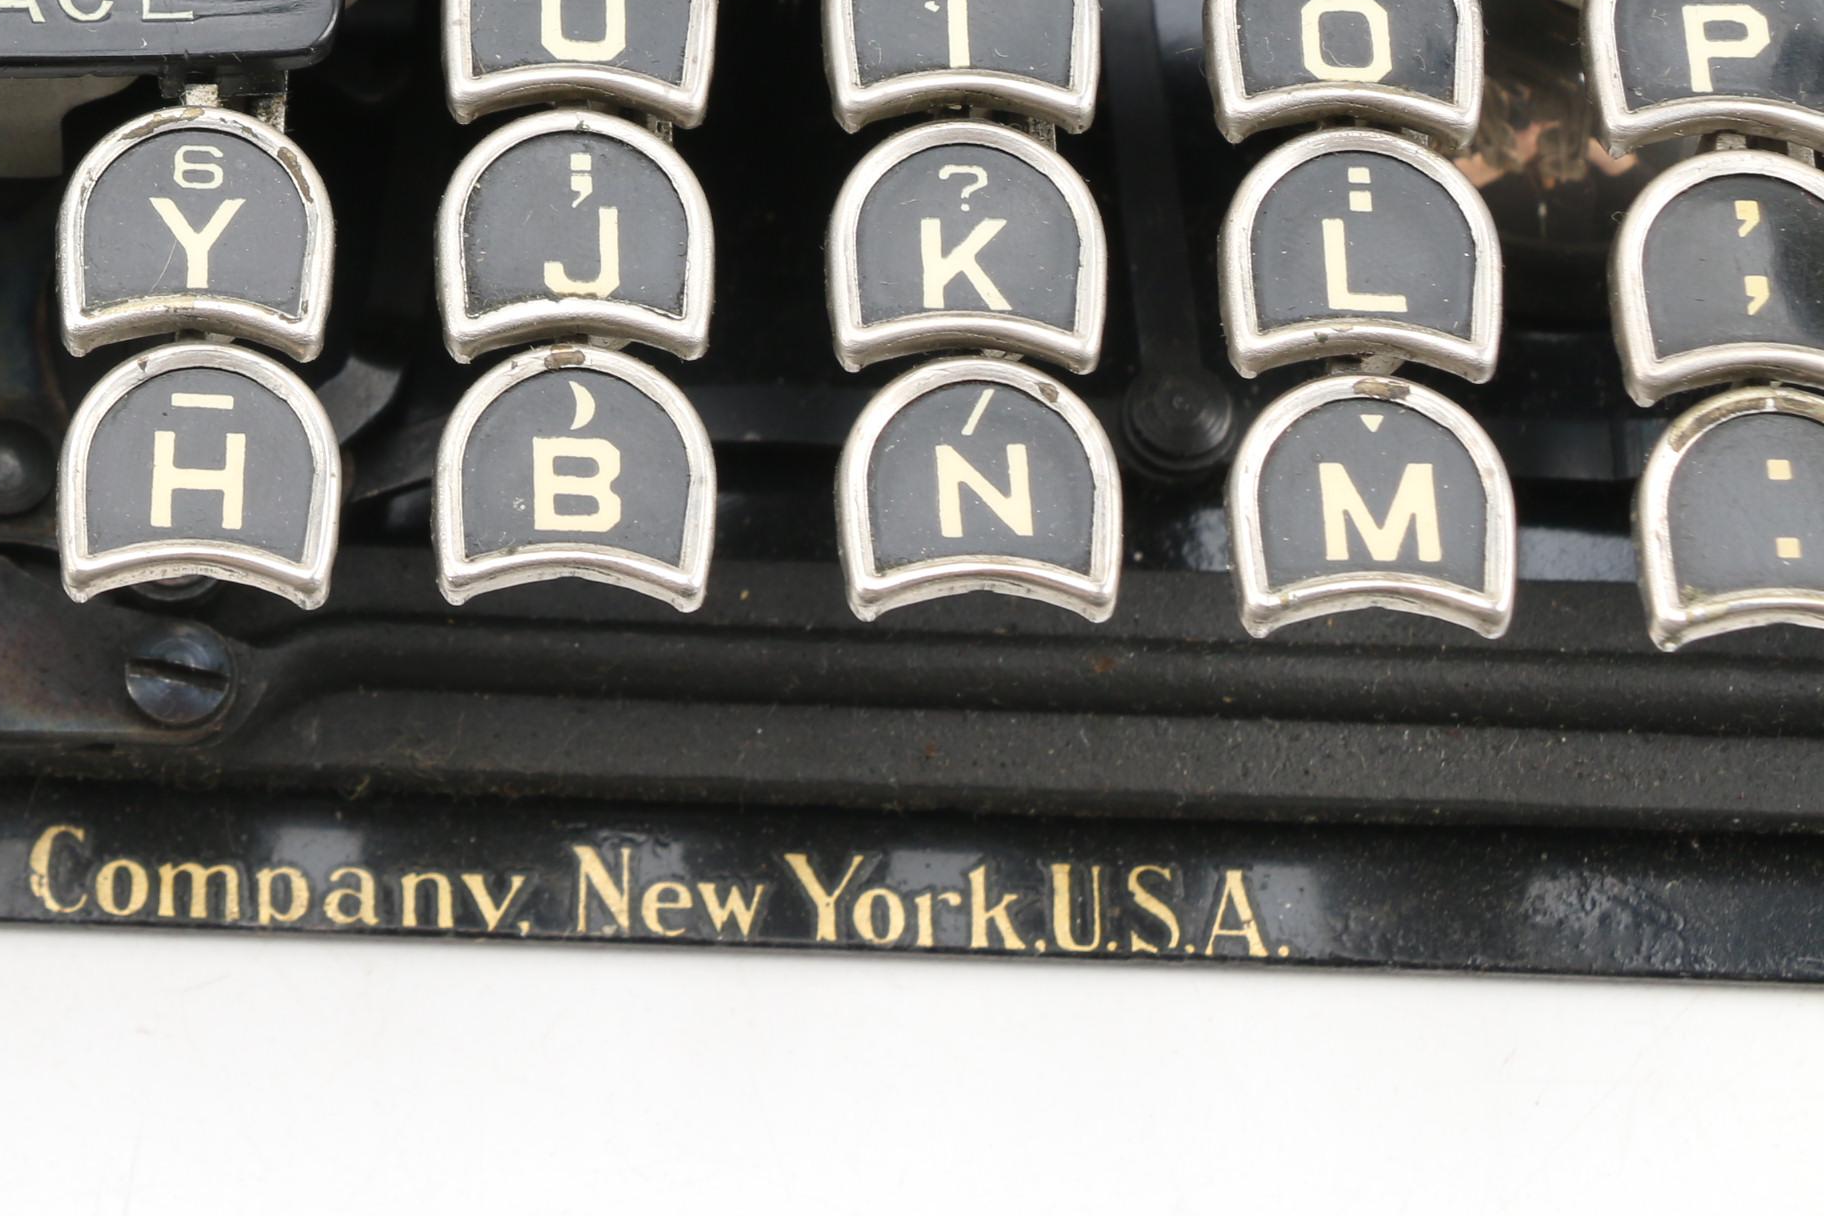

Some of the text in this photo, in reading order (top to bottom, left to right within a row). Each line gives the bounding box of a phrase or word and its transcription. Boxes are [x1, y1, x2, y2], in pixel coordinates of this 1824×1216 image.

[1682, 3, 1771, 92] P
[173, 145, 224, 189] 6
[149, 197, 246, 289] Y
[544, 206, 620, 298] J
[919, 217, 1013, 311] K
[1322, 218, 1408, 312] L
[150, 430, 246, 530] H
[532, 436, 621, 532] B
[935, 443, 1034, 538] N
[1318, 462, 1443, 562] M
[574, 846, 762, 936] New
